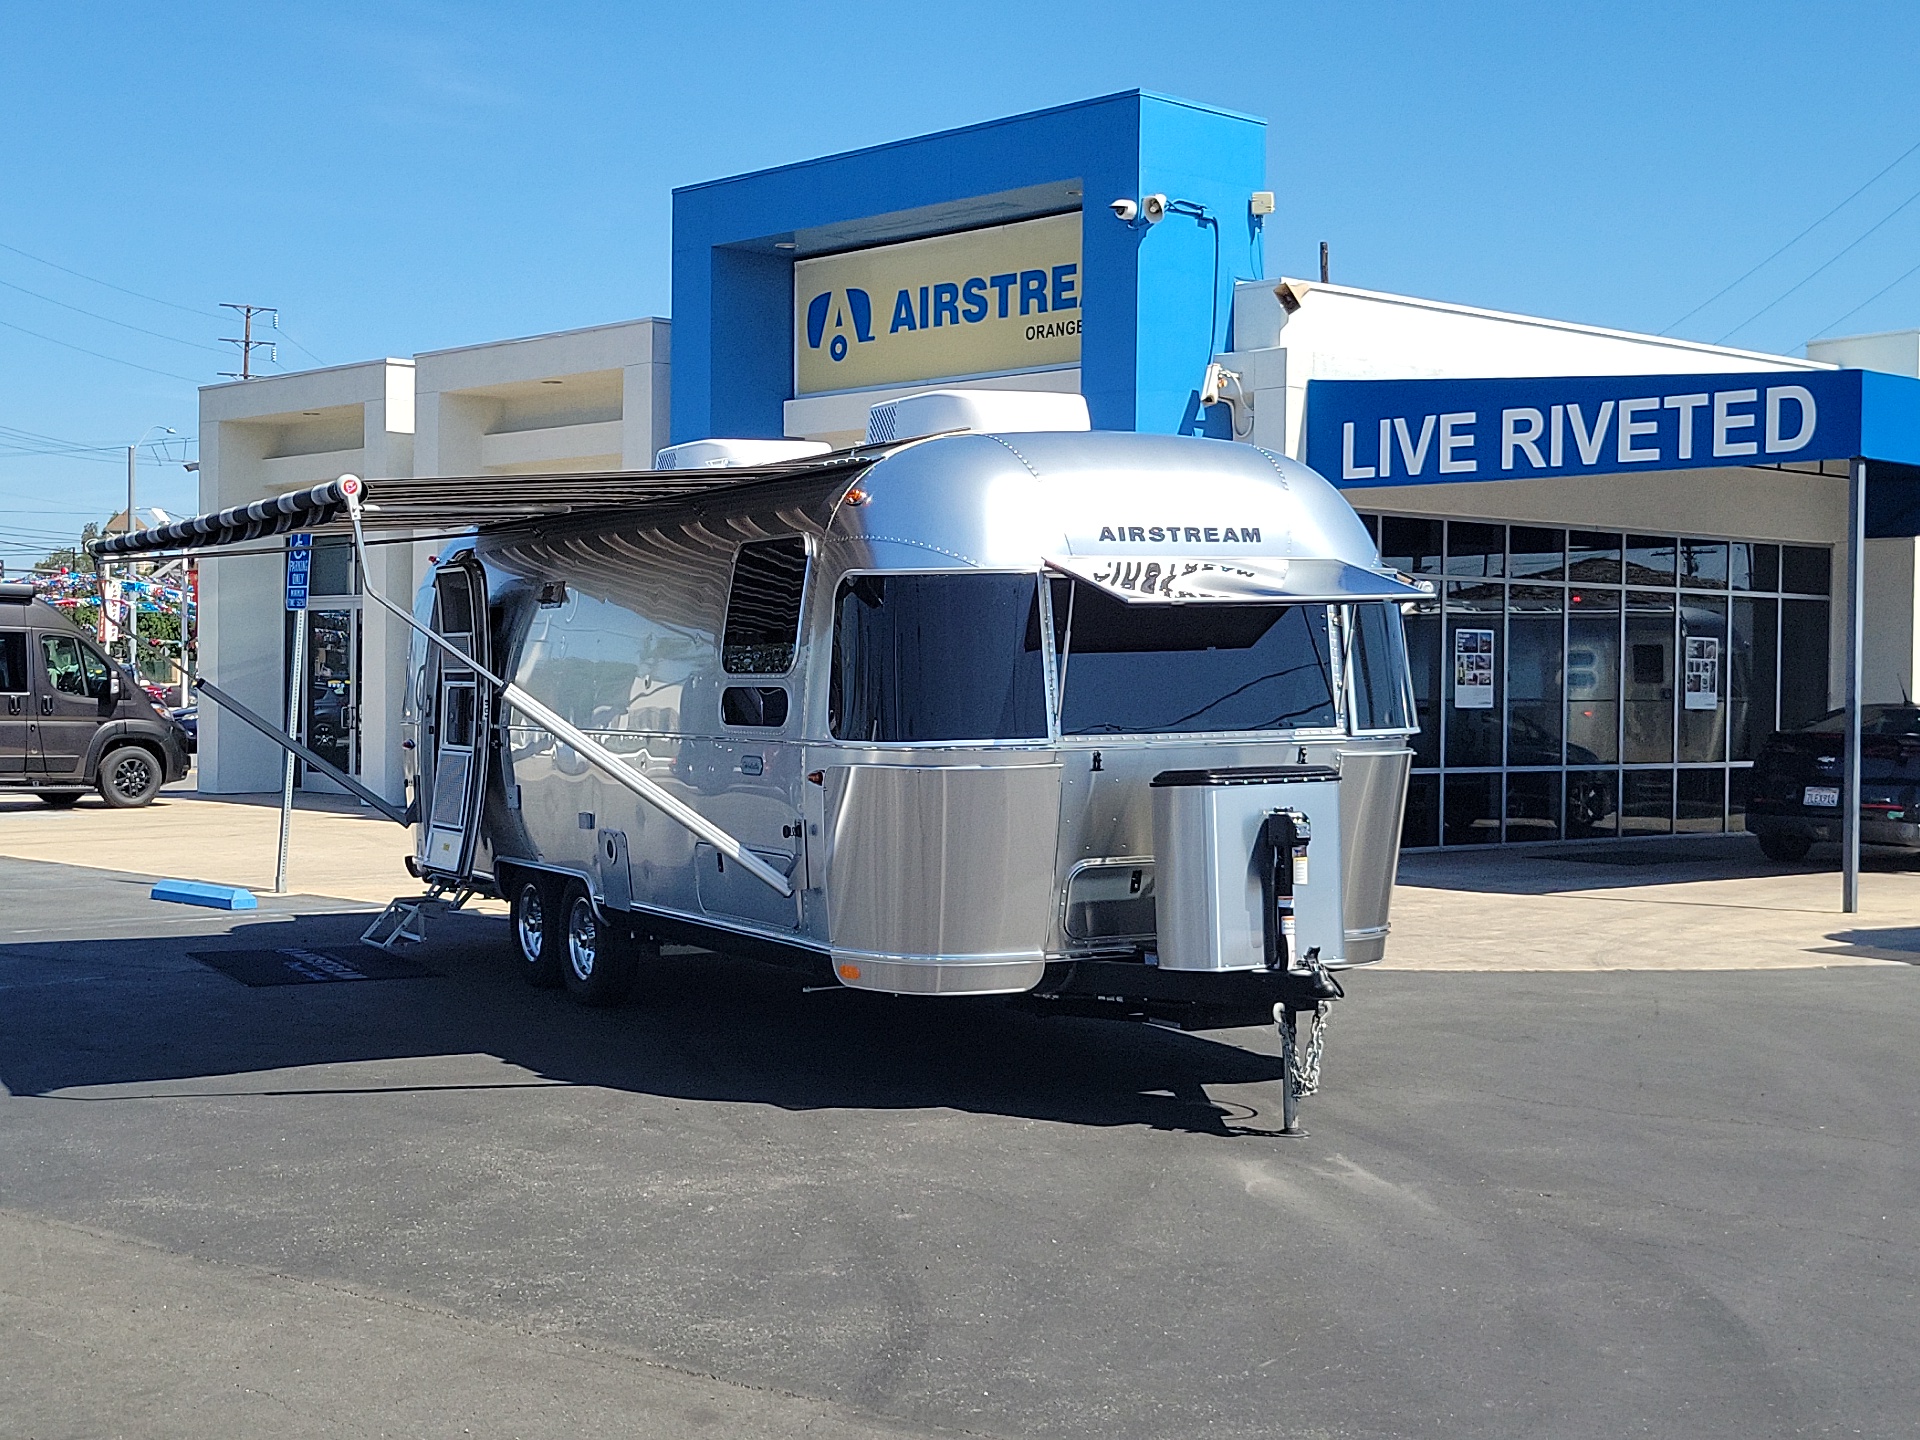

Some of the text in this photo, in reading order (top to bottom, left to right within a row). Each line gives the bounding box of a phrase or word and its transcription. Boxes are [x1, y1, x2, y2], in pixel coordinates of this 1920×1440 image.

[889, 262, 1083, 335] AIRSTRE
[1342, 385, 1817, 480] LIVE RIVETED
[1099, 526, 1262, 543] AIRSTREAM
